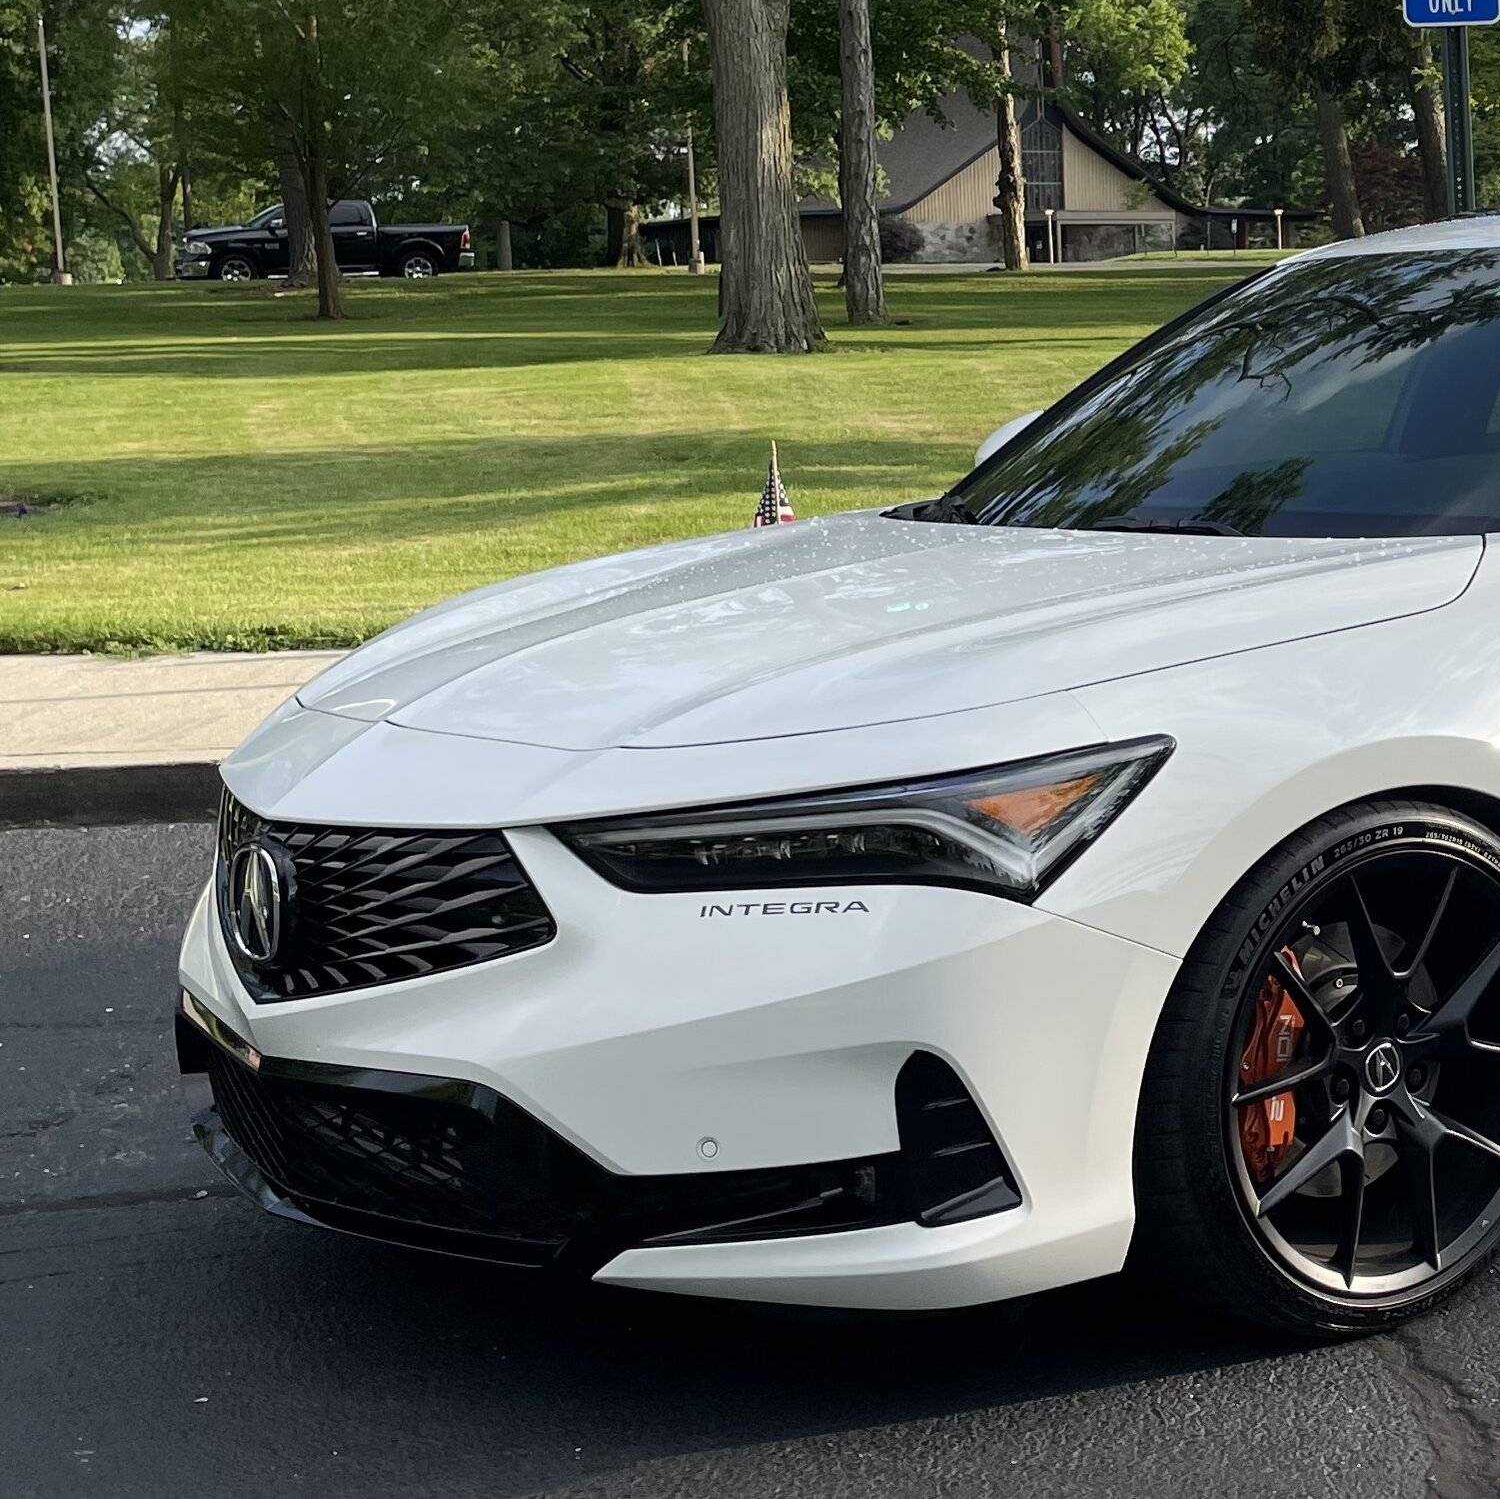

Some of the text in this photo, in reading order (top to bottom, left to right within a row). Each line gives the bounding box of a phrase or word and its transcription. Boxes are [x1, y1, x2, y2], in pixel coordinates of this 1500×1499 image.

[699, 900, 870, 918] INTEGRA
[1238, 855, 1325, 965] MICHELIN
[1375, 828, 1389, 840] ZR
[1392, 826, 1404, 836] 19
